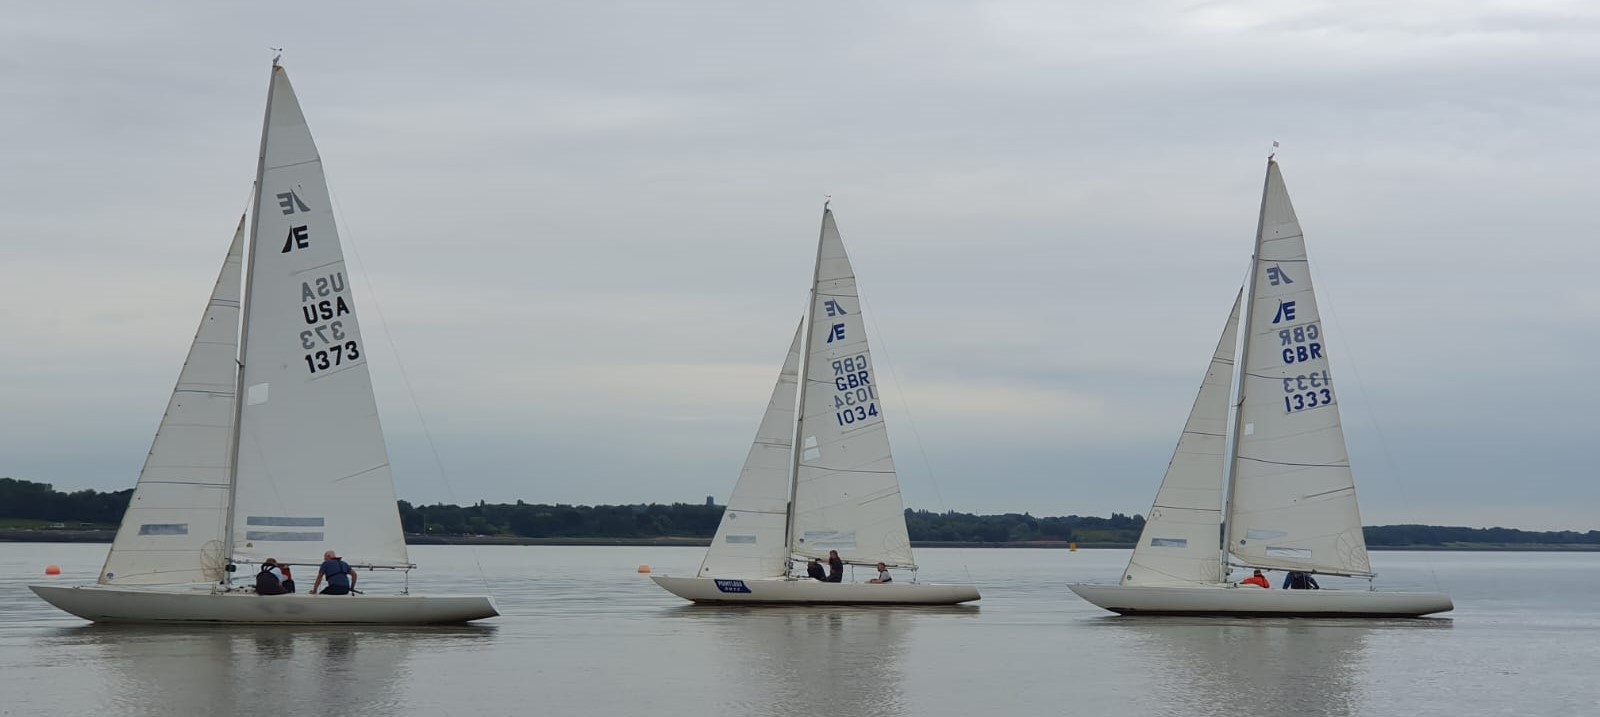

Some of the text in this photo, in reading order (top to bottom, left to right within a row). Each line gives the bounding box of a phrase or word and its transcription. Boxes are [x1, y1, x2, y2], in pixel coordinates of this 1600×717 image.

[302, 296, 350, 324] USA
[305, 340, 360, 373] 1373
[1282, 343, 1322, 364] GBR
[835, 370, 870, 391] GBR
[1285, 388, 1332, 412] 1333
[836, 403, 878, 426] 1034
